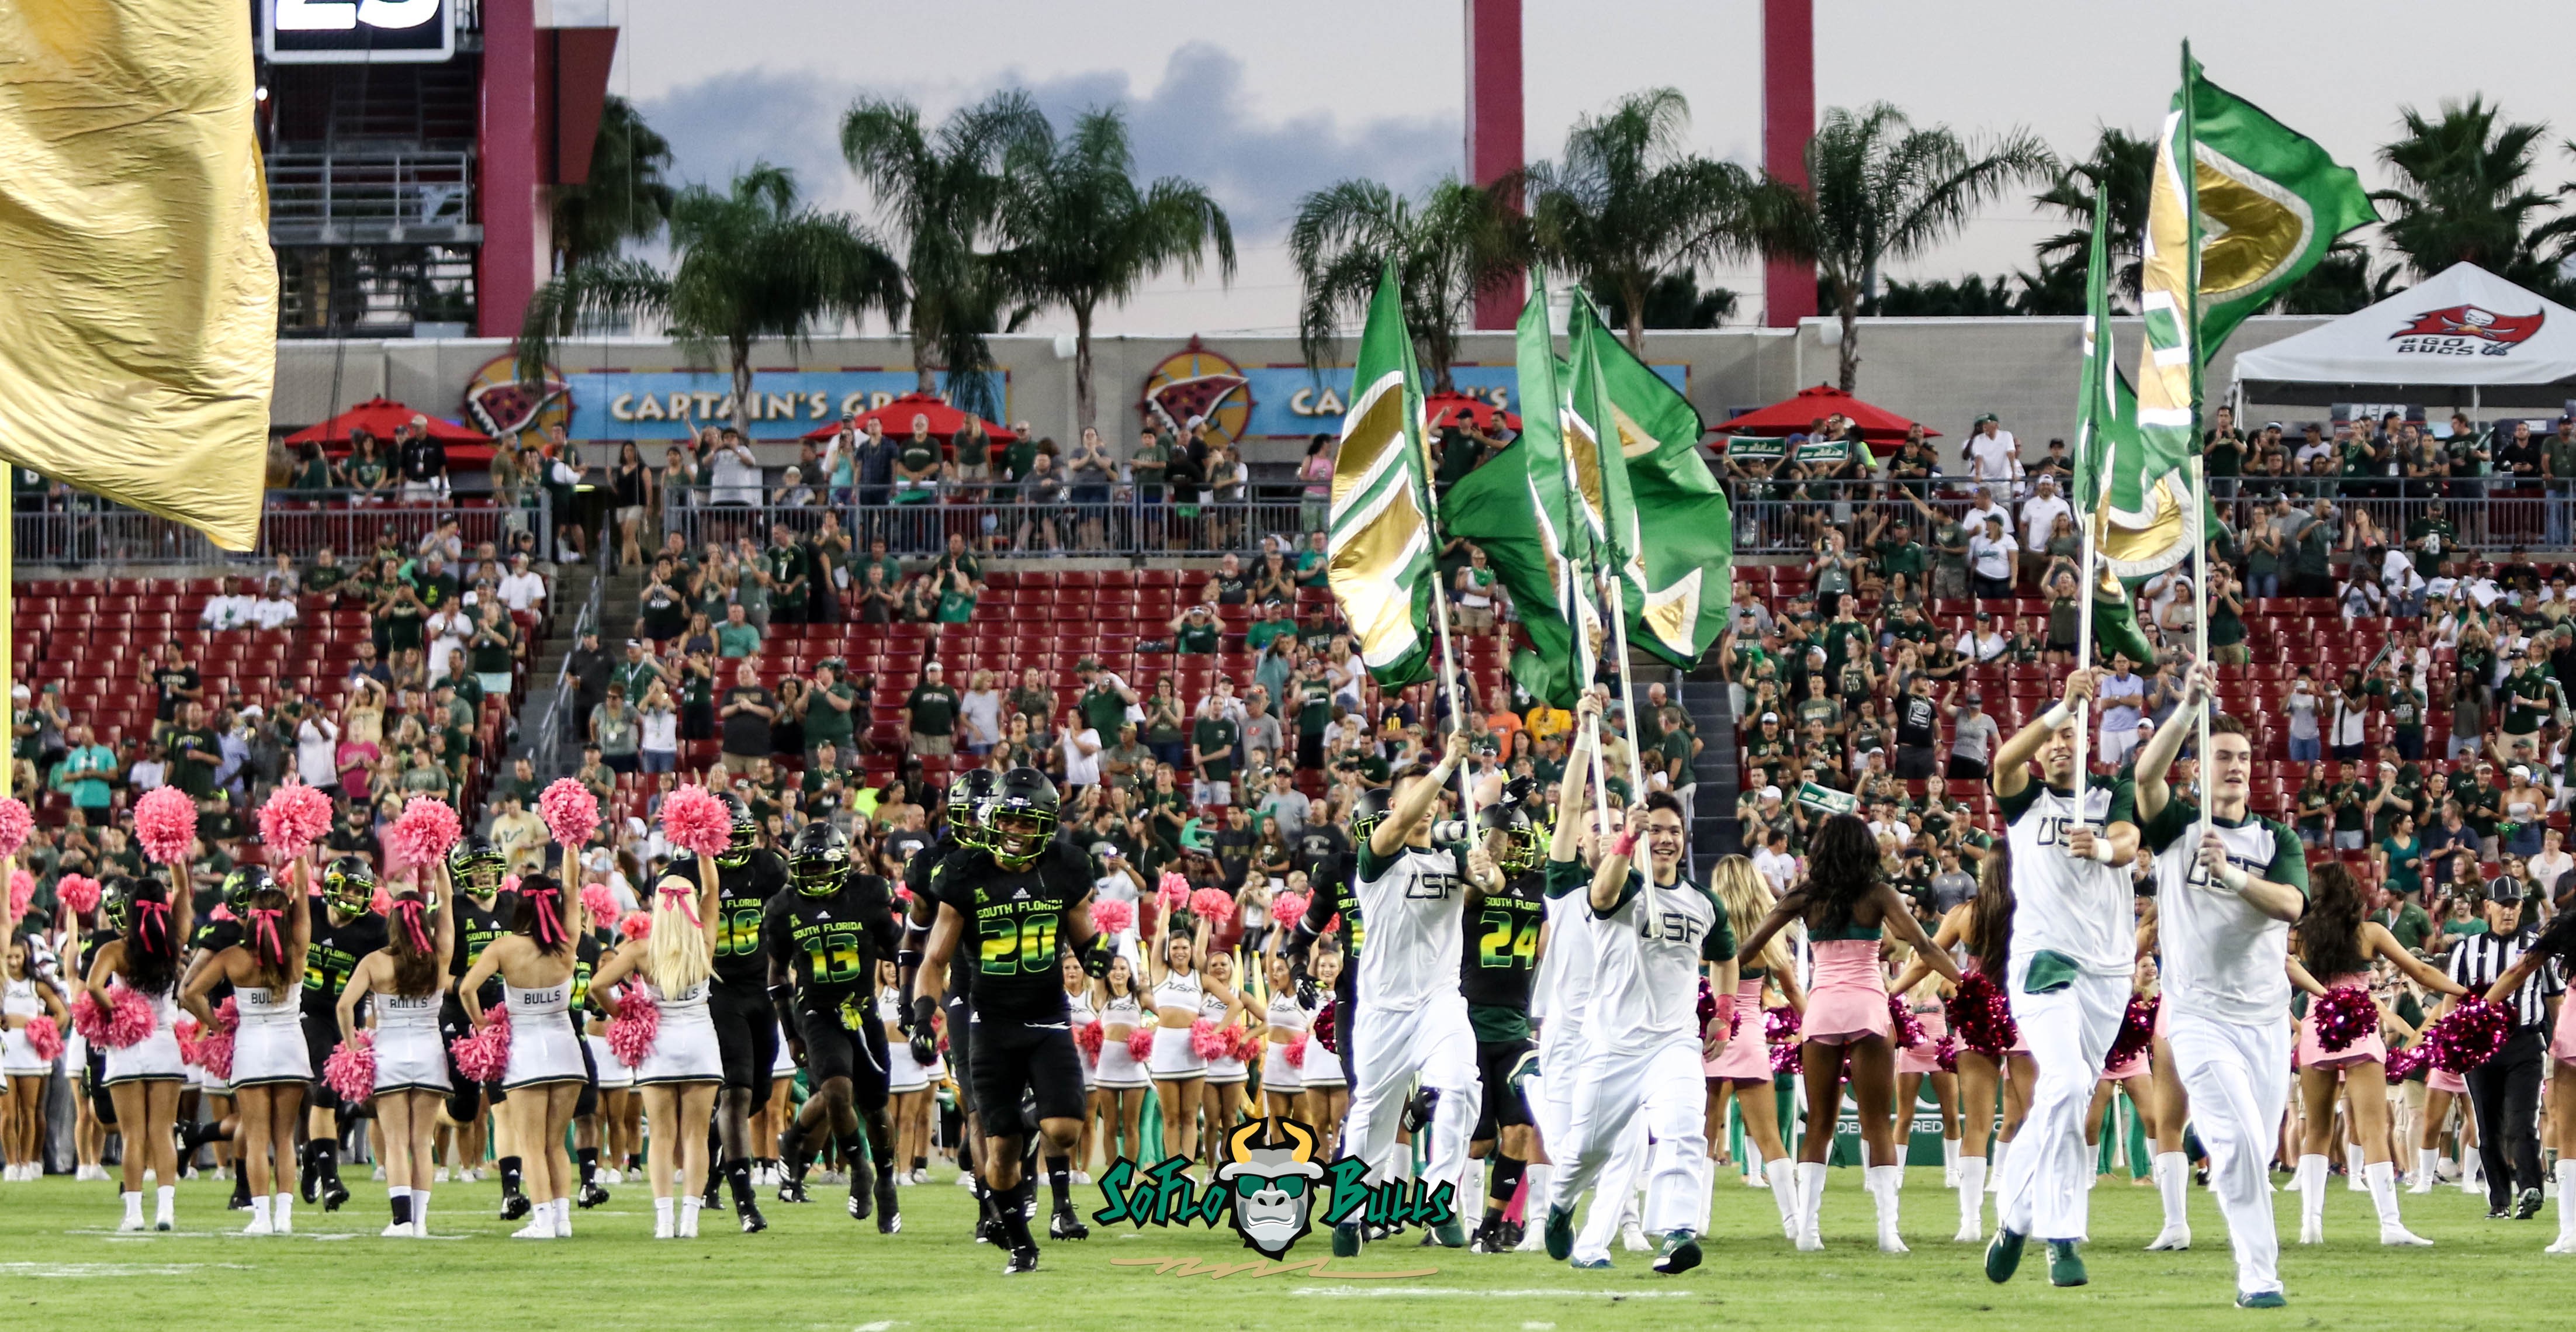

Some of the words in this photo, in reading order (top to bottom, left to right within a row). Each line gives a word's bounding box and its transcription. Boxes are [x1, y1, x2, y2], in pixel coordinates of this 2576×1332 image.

[2401, 337, 2464, 346] #GO
[2398, 345, 2474, 355] BUCS
[726, 898, 762, 908] FLORIDA
[1338, 897, 1359, 909] SOUT
[1484, 896, 1512, 908] SOUTH
[977, 903, 1013, 919] SOUTH
[466, 930, 493, 942] SOUTH
[792, 925, 820, 941] SOUTH
[823, 921, 864, 933] FLORIDA
[979, 913, 1059, 975] 20
[1480, 910, 1542, 970] 24
[803, 933, 861, 983] 13
[251, 992, 272, 1004] BUL
[524, 990, 561, 1005] BULLS
